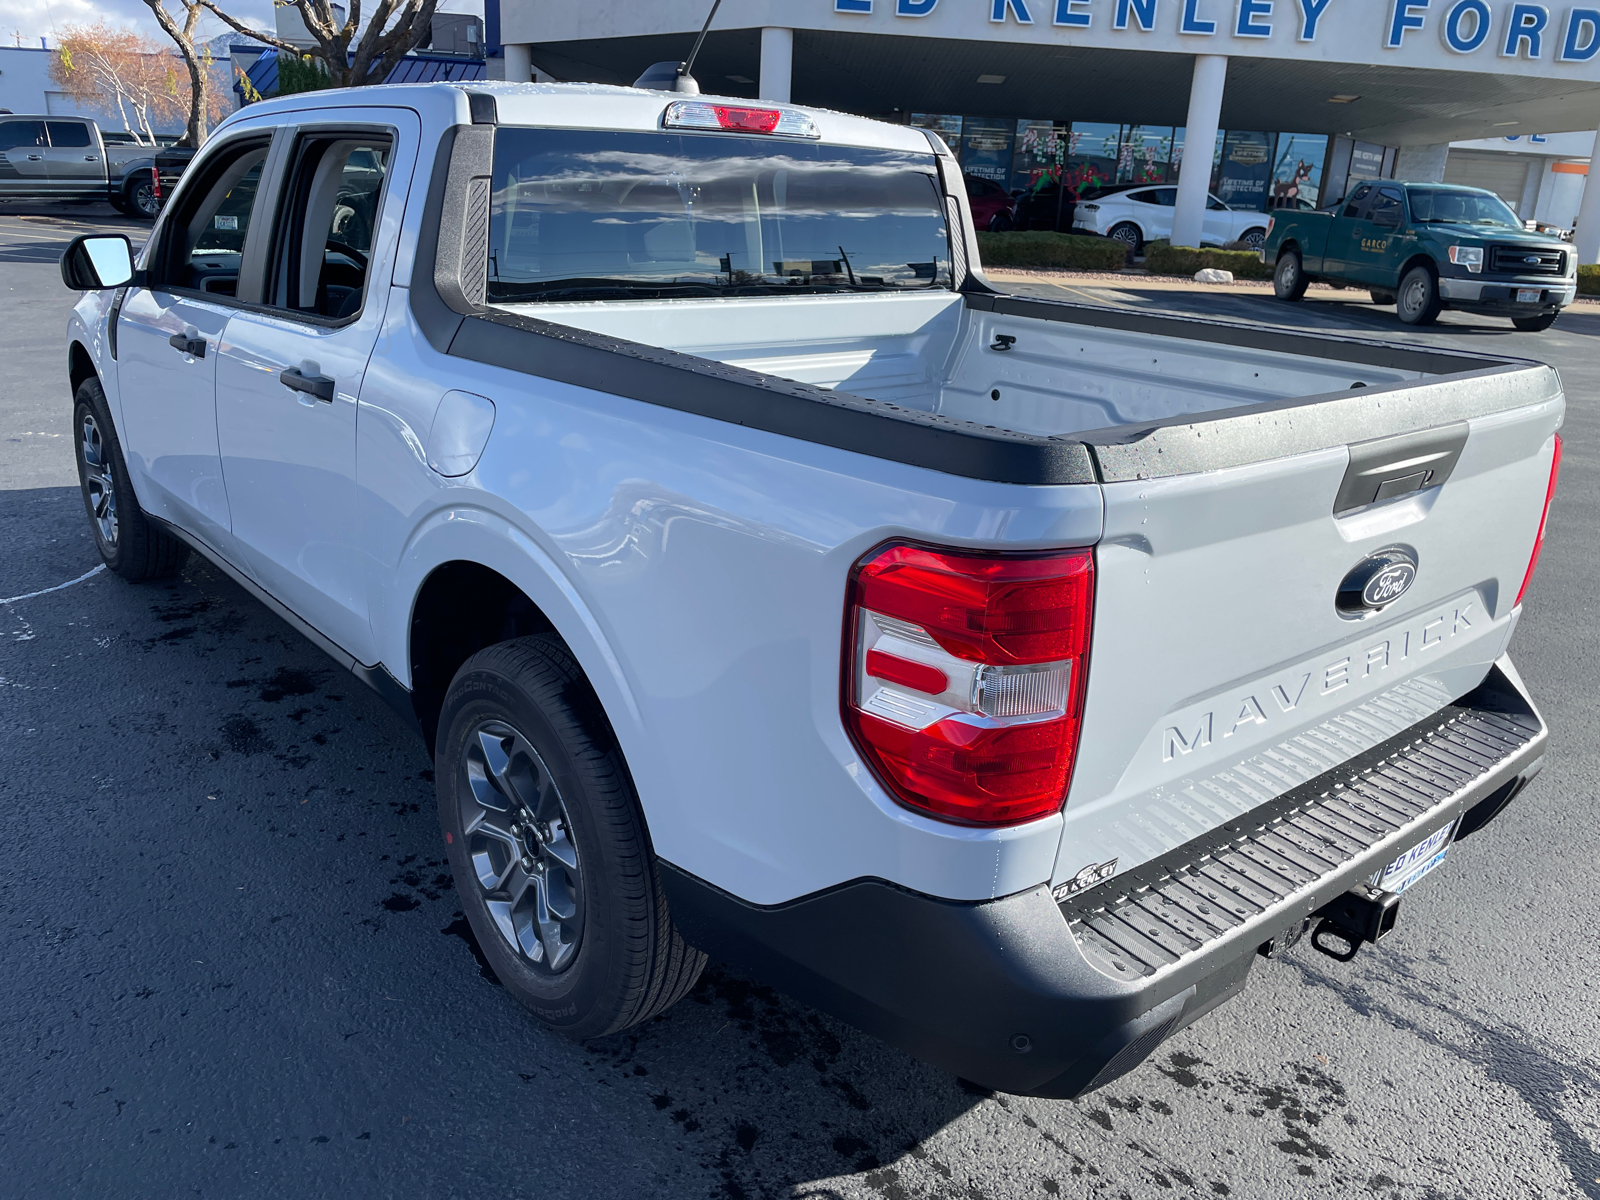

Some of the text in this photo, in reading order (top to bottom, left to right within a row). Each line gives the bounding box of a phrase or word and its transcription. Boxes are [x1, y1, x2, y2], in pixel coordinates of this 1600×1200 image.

[1383, 0, 1600, 62] FORD
[970, 172, 1006, 180] OTECTION
[1361, 238, 1387, 249] GARCO
[1373, 569, 1408, 601] Ford
[1162, 601, 1473, 763] MAVERICK
